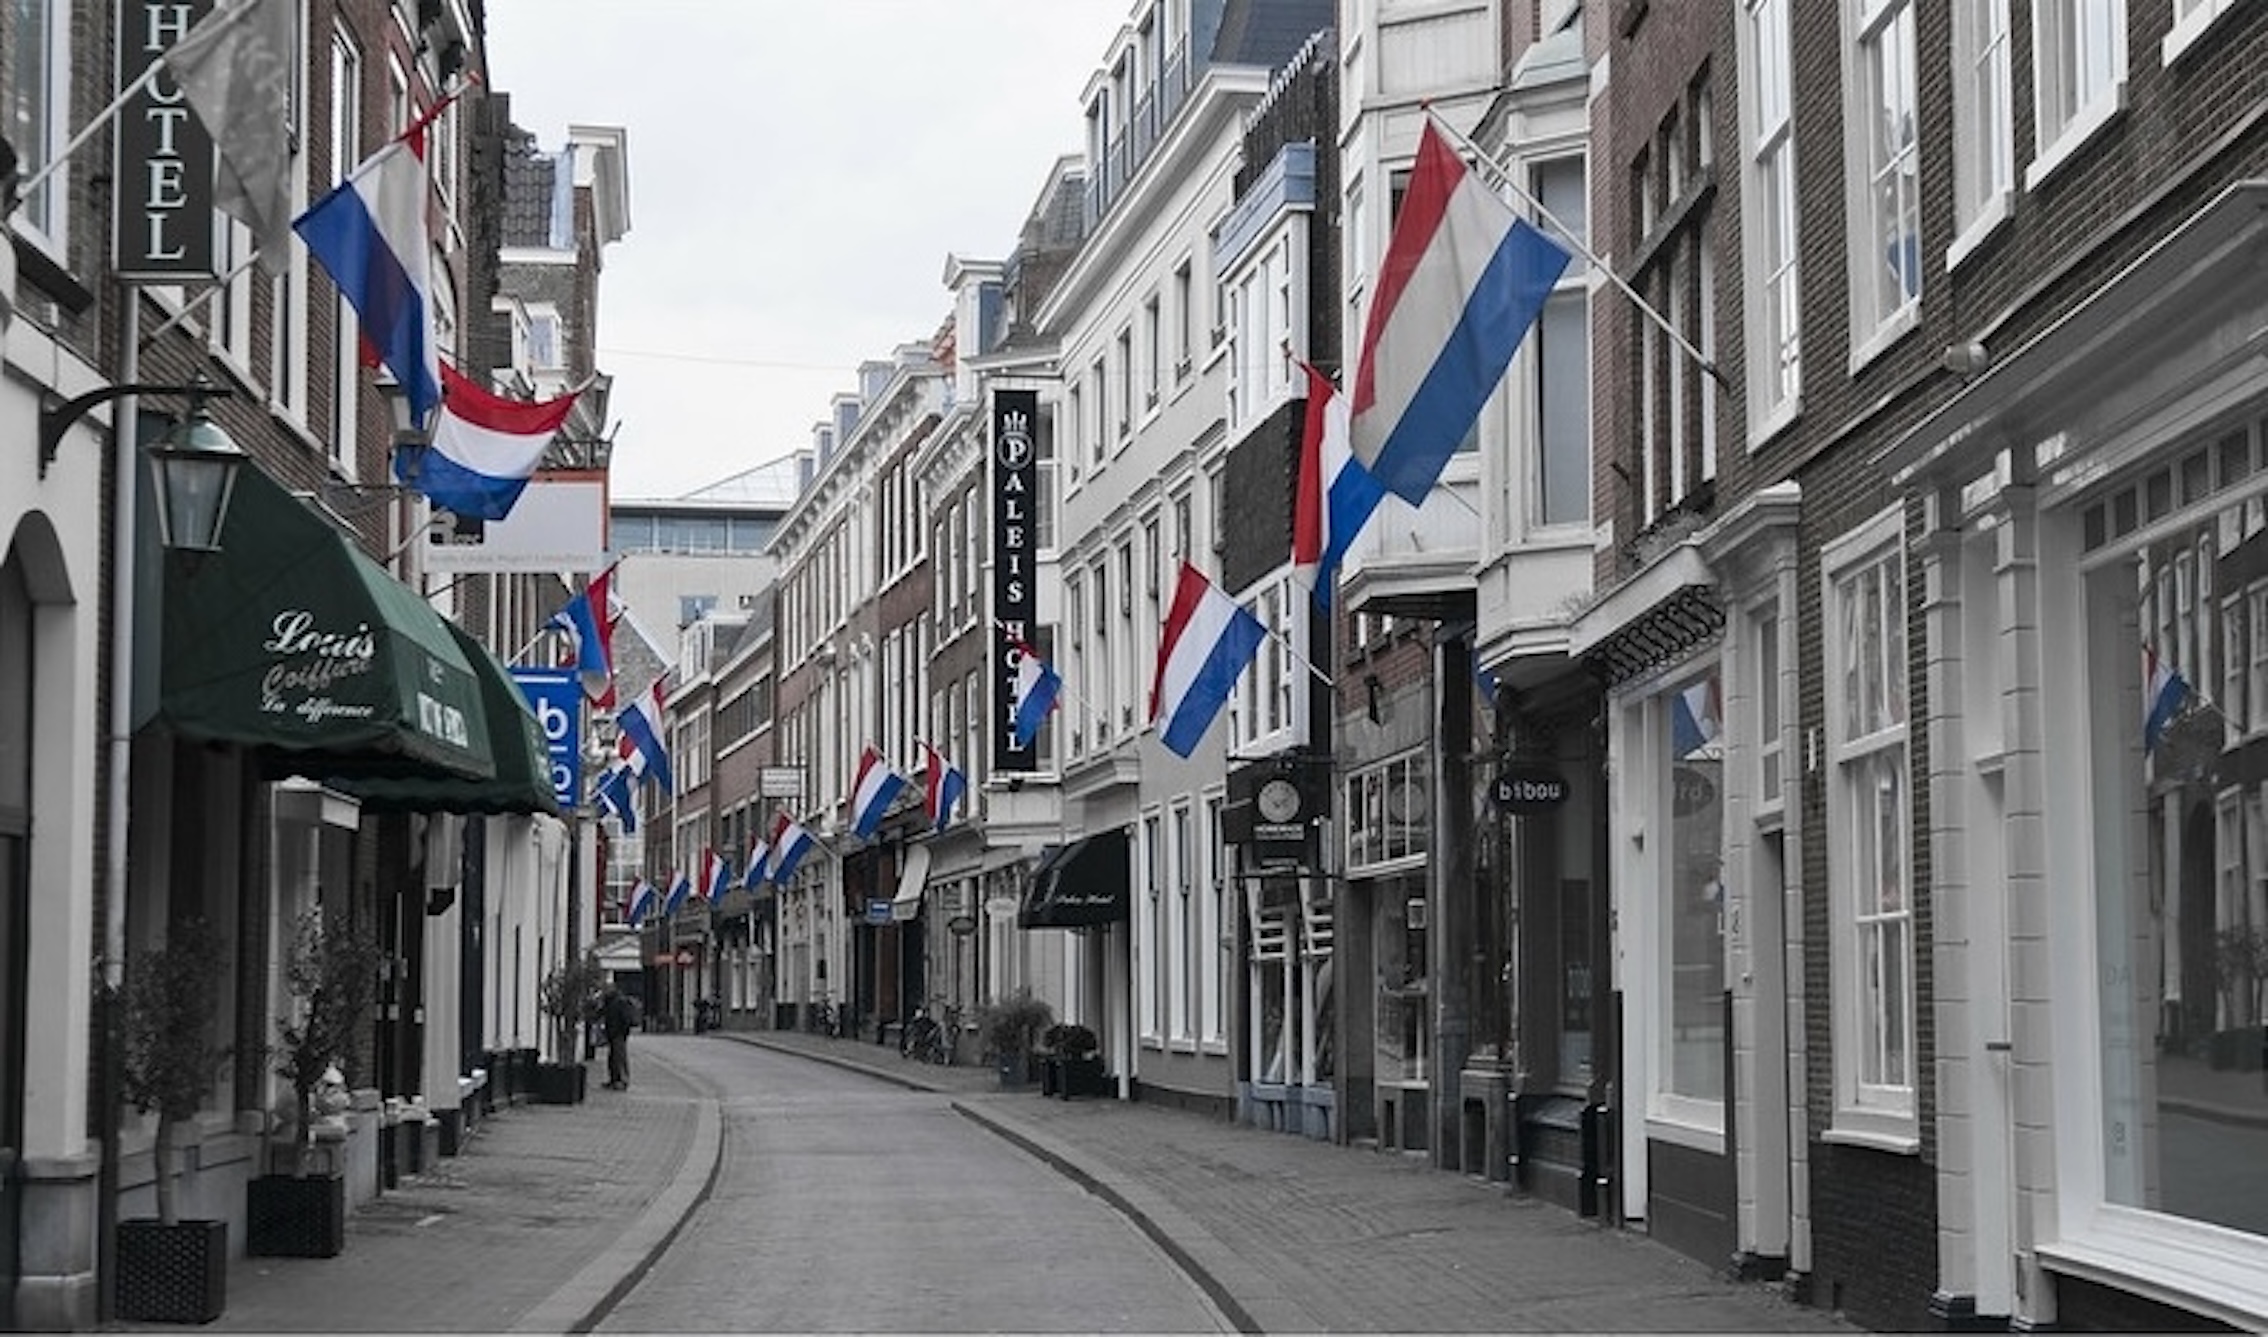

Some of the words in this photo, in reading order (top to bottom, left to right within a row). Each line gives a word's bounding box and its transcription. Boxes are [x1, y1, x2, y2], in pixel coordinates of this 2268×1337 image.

[1003, 436, 1028, 603] PALEIS
[263, 610, 375, 657] Louis
[262, 658, 373, 696] Coiffure
[1500, 780, 1561, 800] bibou
